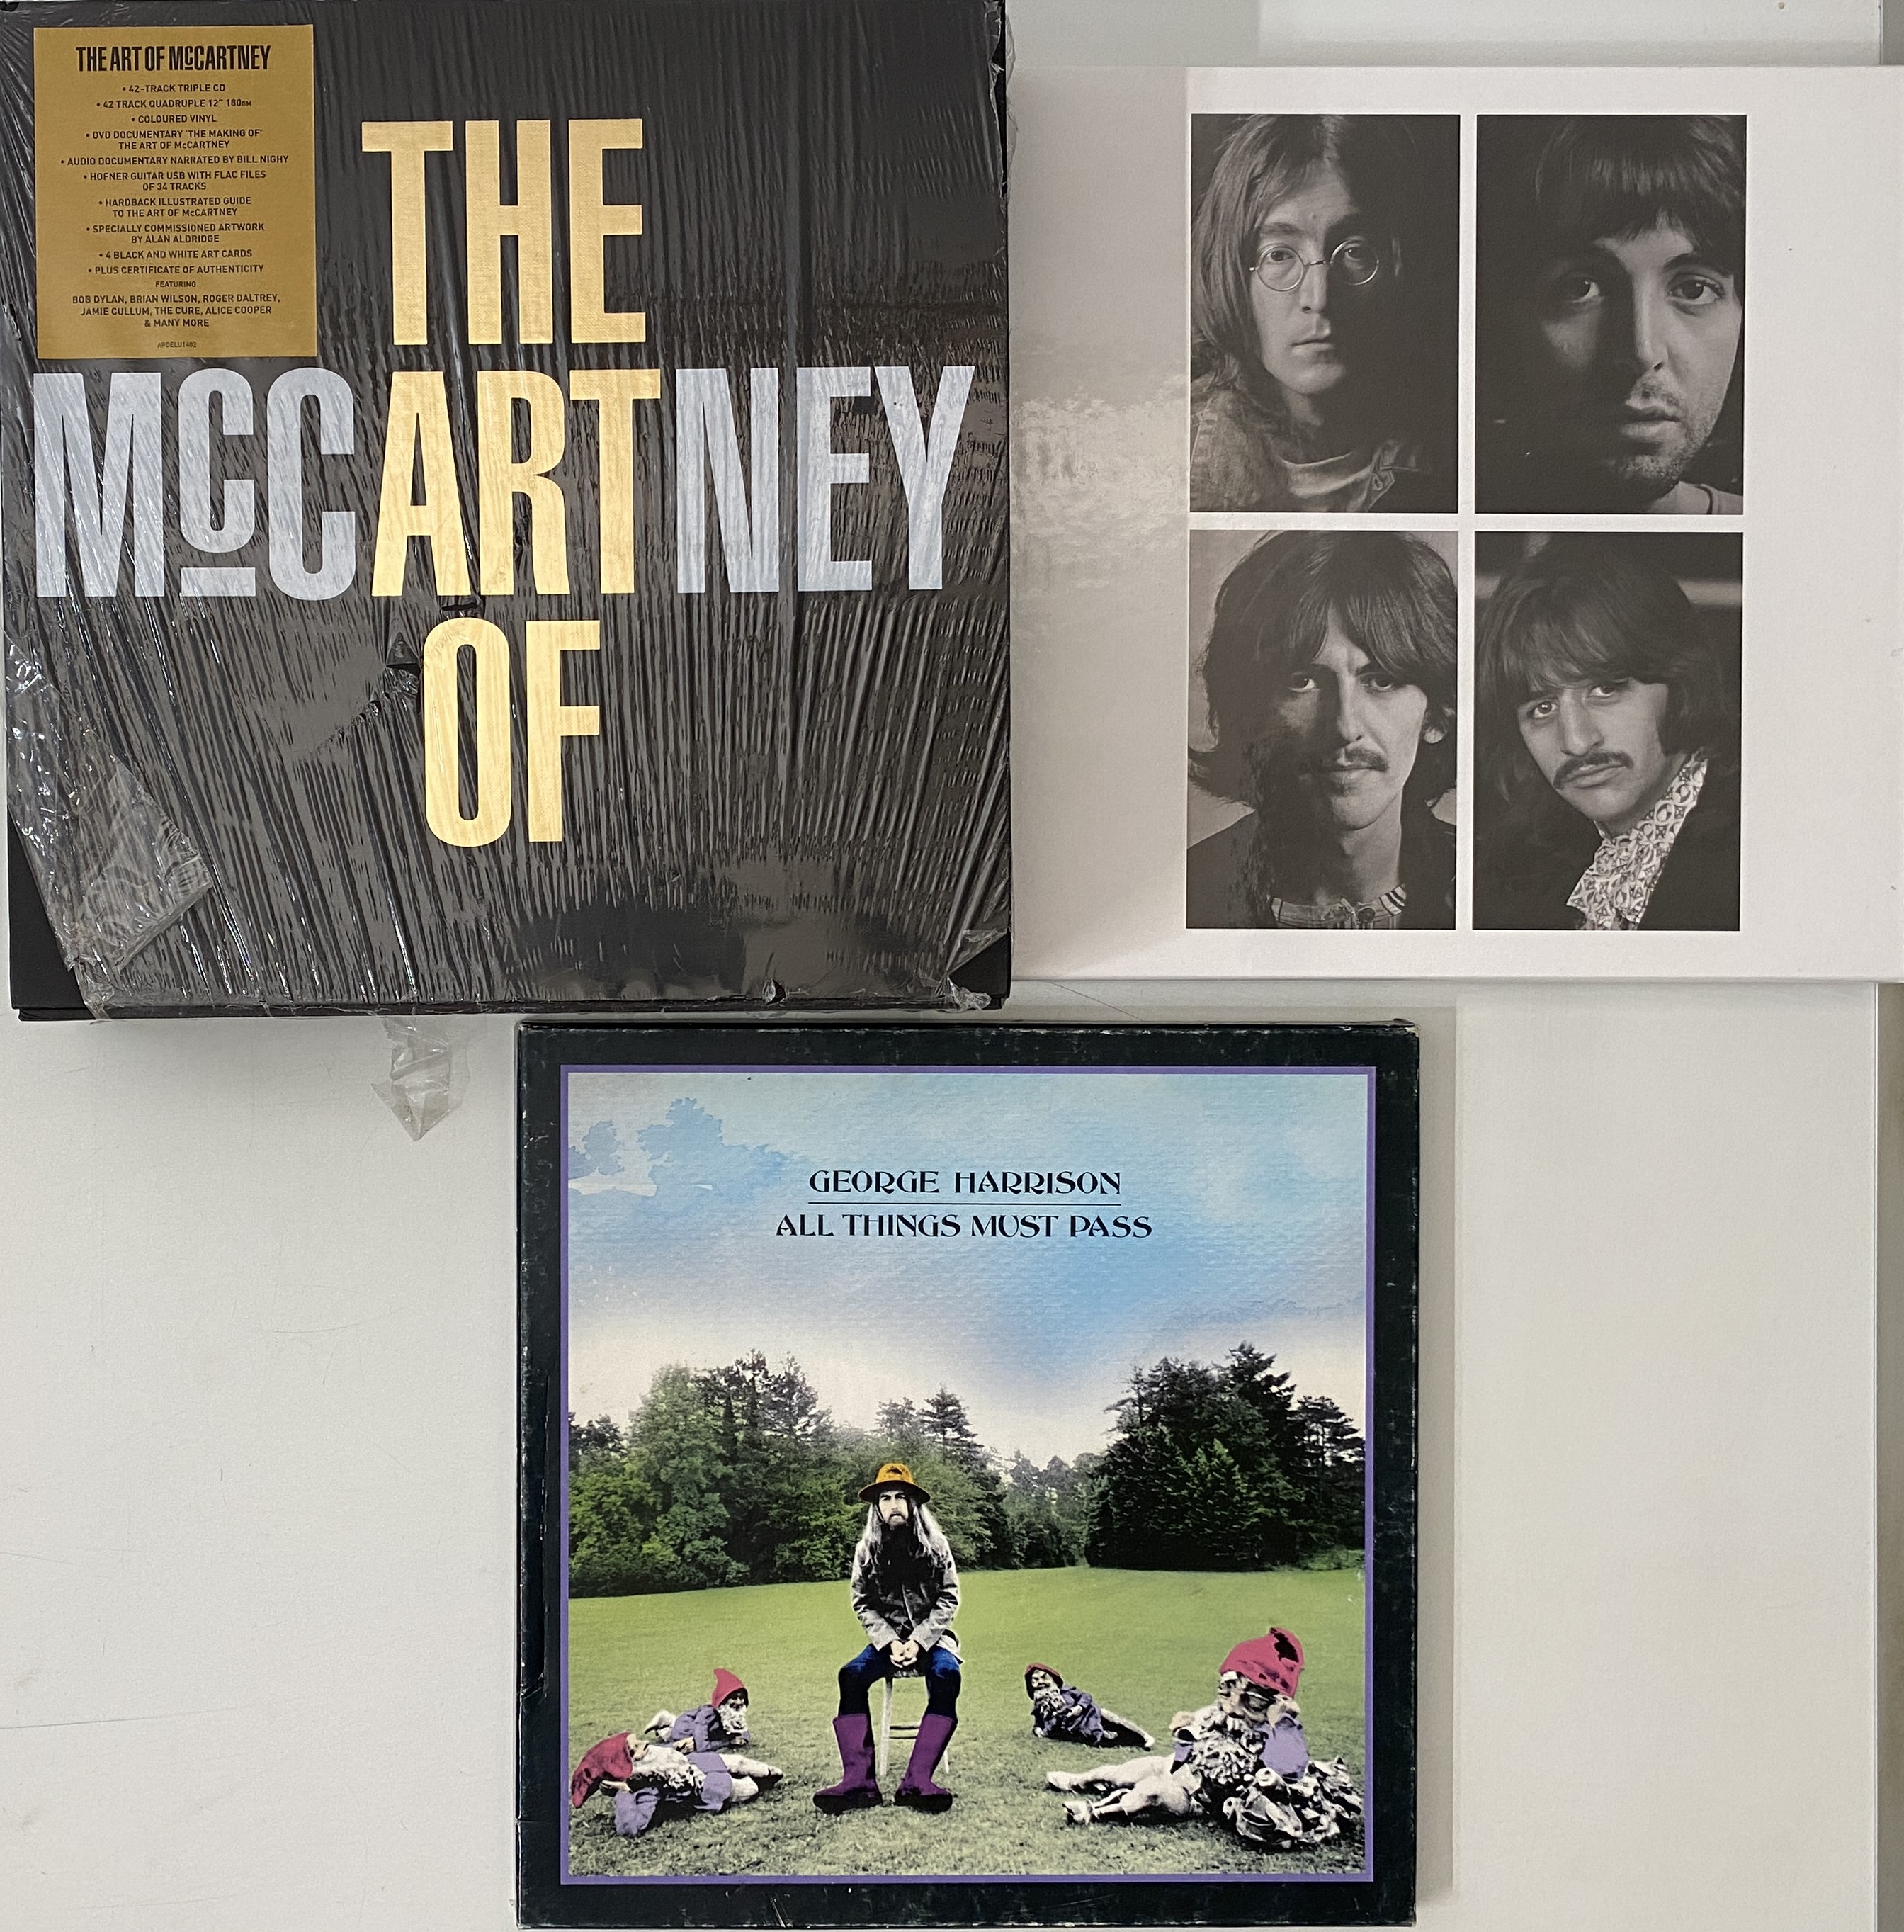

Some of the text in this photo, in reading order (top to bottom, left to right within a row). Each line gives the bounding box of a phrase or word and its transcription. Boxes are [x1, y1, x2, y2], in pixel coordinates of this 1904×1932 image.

[76, 47, 107, 72] THE
[110, 46, 142, 71] ART
[145, 46, 165, 71] OF
[129, 84, 176, 93] 42-TRACK
[116, 100, 147, 108] TRACK
[149, 99, 205, 108] QUADRUPLE
[138, 115, 187, 123] COLOURED
[209, 129, 245, 137] MAKING
[175, 140, 230, 149] McCARTNEY
[98, 157, 167, 165] DOCUMENTARY
[171, 156, 220, 164] NARRATED
[188, 171, 211, 179] WITH
[361, 118, 646, 346] THE
[145, 235, 170, 243] ALAN
[173, 235, 219, 243] ALDRIDGE
[169, 250, 198, 259] WHITE
[121, 266, 180, 274] CERTIFICATE
[197, 265, 264, 273] AUTHENTICITY
[94, 295, 127, 304] DYLAN,
[161, 295, 200, 304] WILSON,
[237, 294, 280, 303] DALTREY,
[111, 307, 152, 316] CULLUM,
[176, 307, 203, 315] CURE,
[423, 616, 601, 847] OF
[809, 1170, 1121, 1195] GEORGE HARRISON
[776, 1214, 1153, 1238] ALL THINGS MUST PASS
